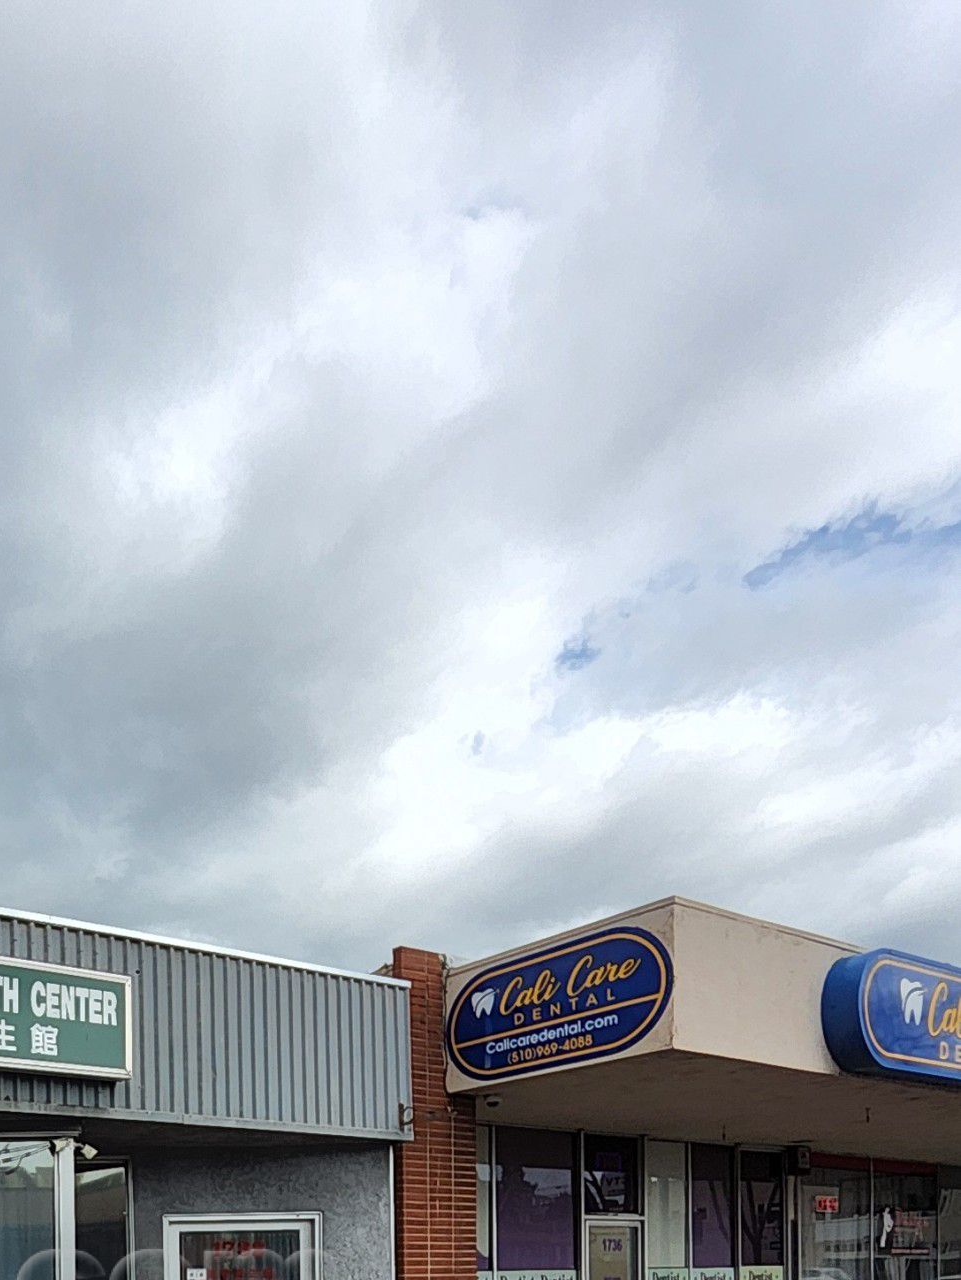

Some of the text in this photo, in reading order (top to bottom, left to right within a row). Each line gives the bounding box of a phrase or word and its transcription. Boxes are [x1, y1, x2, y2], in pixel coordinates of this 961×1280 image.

[30, 980, 118, 1026] CENTER
[499, 955, 641, 1016] Cali Care
[513, 987, 616, 1026] DENTAL
[485, 1012, 619, 1055] Calicaredental.com
[507, 1034, 594, 1065] (510)969-4088
[602, 1238, 623, 1252] 1736
